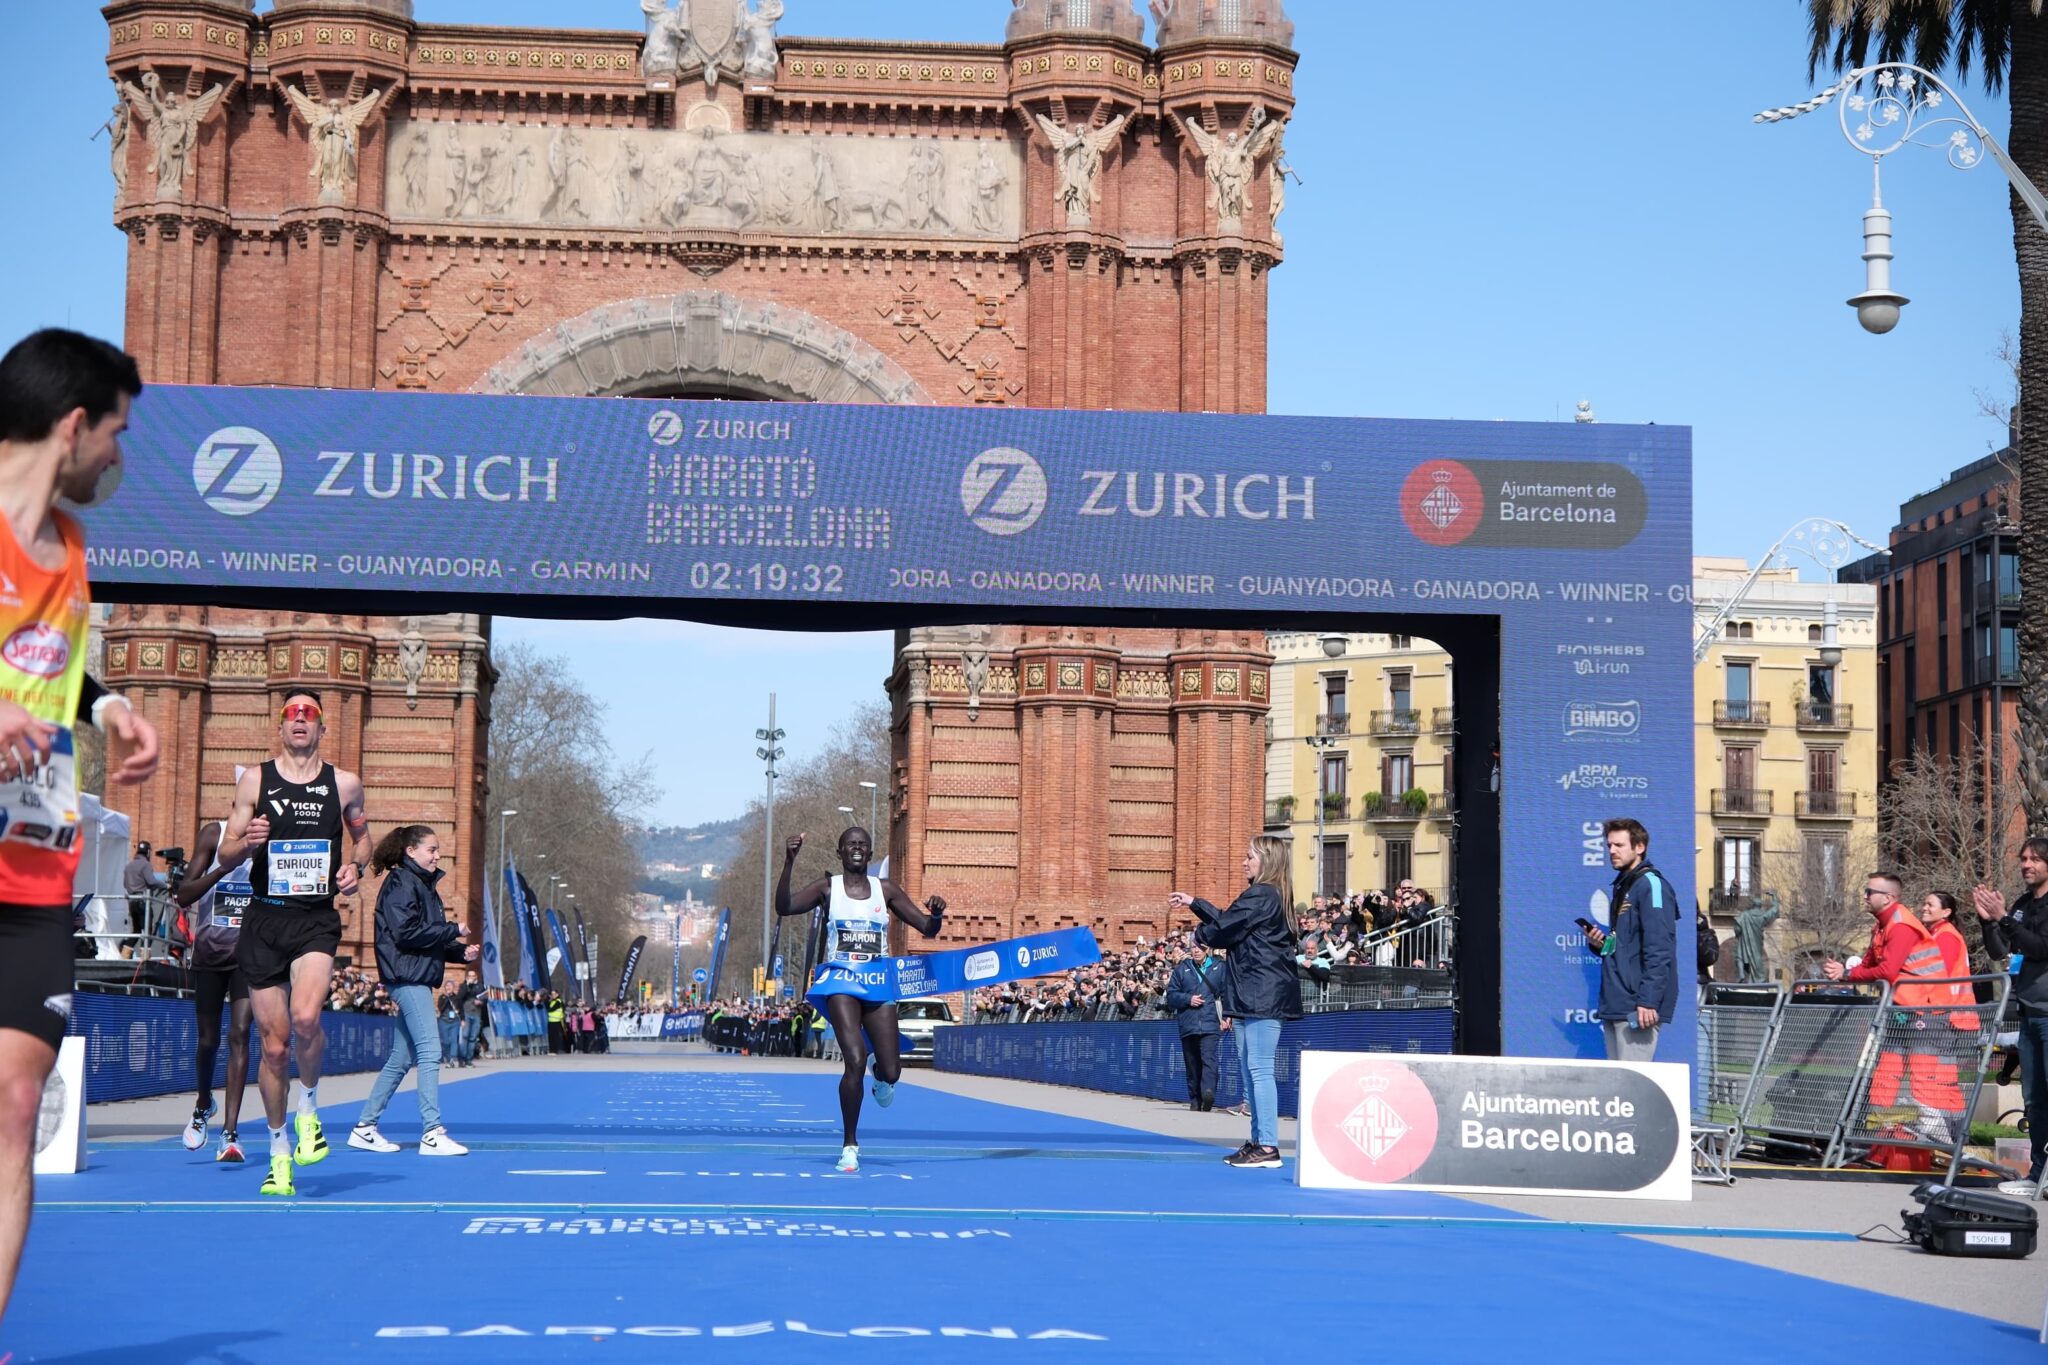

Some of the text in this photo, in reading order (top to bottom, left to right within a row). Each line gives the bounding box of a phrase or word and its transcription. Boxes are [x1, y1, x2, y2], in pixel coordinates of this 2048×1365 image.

[695, 419, 790, 440] ZURICH
[313, 450, 557, 502] ZURICH
[1078, 470, 1315, 520] ZURICH
[1500, 480, 1617, 501] Ajuntament de
[1500, 501, 1617, 524] Barcelona
[646, 502, 891, 549] BARCELONA
[85, 547, 202, 570] ANADORA
[221, 551, 318, 573] WINNER
[338, 554, 504, 579] GUANYADORA
[531, 560, 651, 581] GARMIN
[690, 561, 844, 592] 02:19:32
[970, 570, 1103, 592] GANADORA
[1122, 573, 1215, 594] WINNER
[1239, 575, 1395, 598] GUANYADORA
[1413, 579, 1541, 601] GANADORA
[1560, 582, 1649, 602] WINNER
[1557, 644, 1645, 656] FINISHERS
[1570, 710, 1635, 728] BIMBO
[1579, 764, 1618, 776] RPM
[1580, 776, 1649, 789] SPORTS
[291, 802, 324, 812] VICKY
[294, 810, 321, 818] FOODS
[277, 858, 323, 870] ENRIQUE
[842, 932, 877, 943] SHARON
[1032, 946, 1058, 961] ZURICH
[618, 946, 640, 1000] GARMIN
[833, 968, 886, 985] ZURICH
[1461, 1091, 1635, 1118] Ajuntament de
[1461, 1119, 1637, 1156] Barcelona
